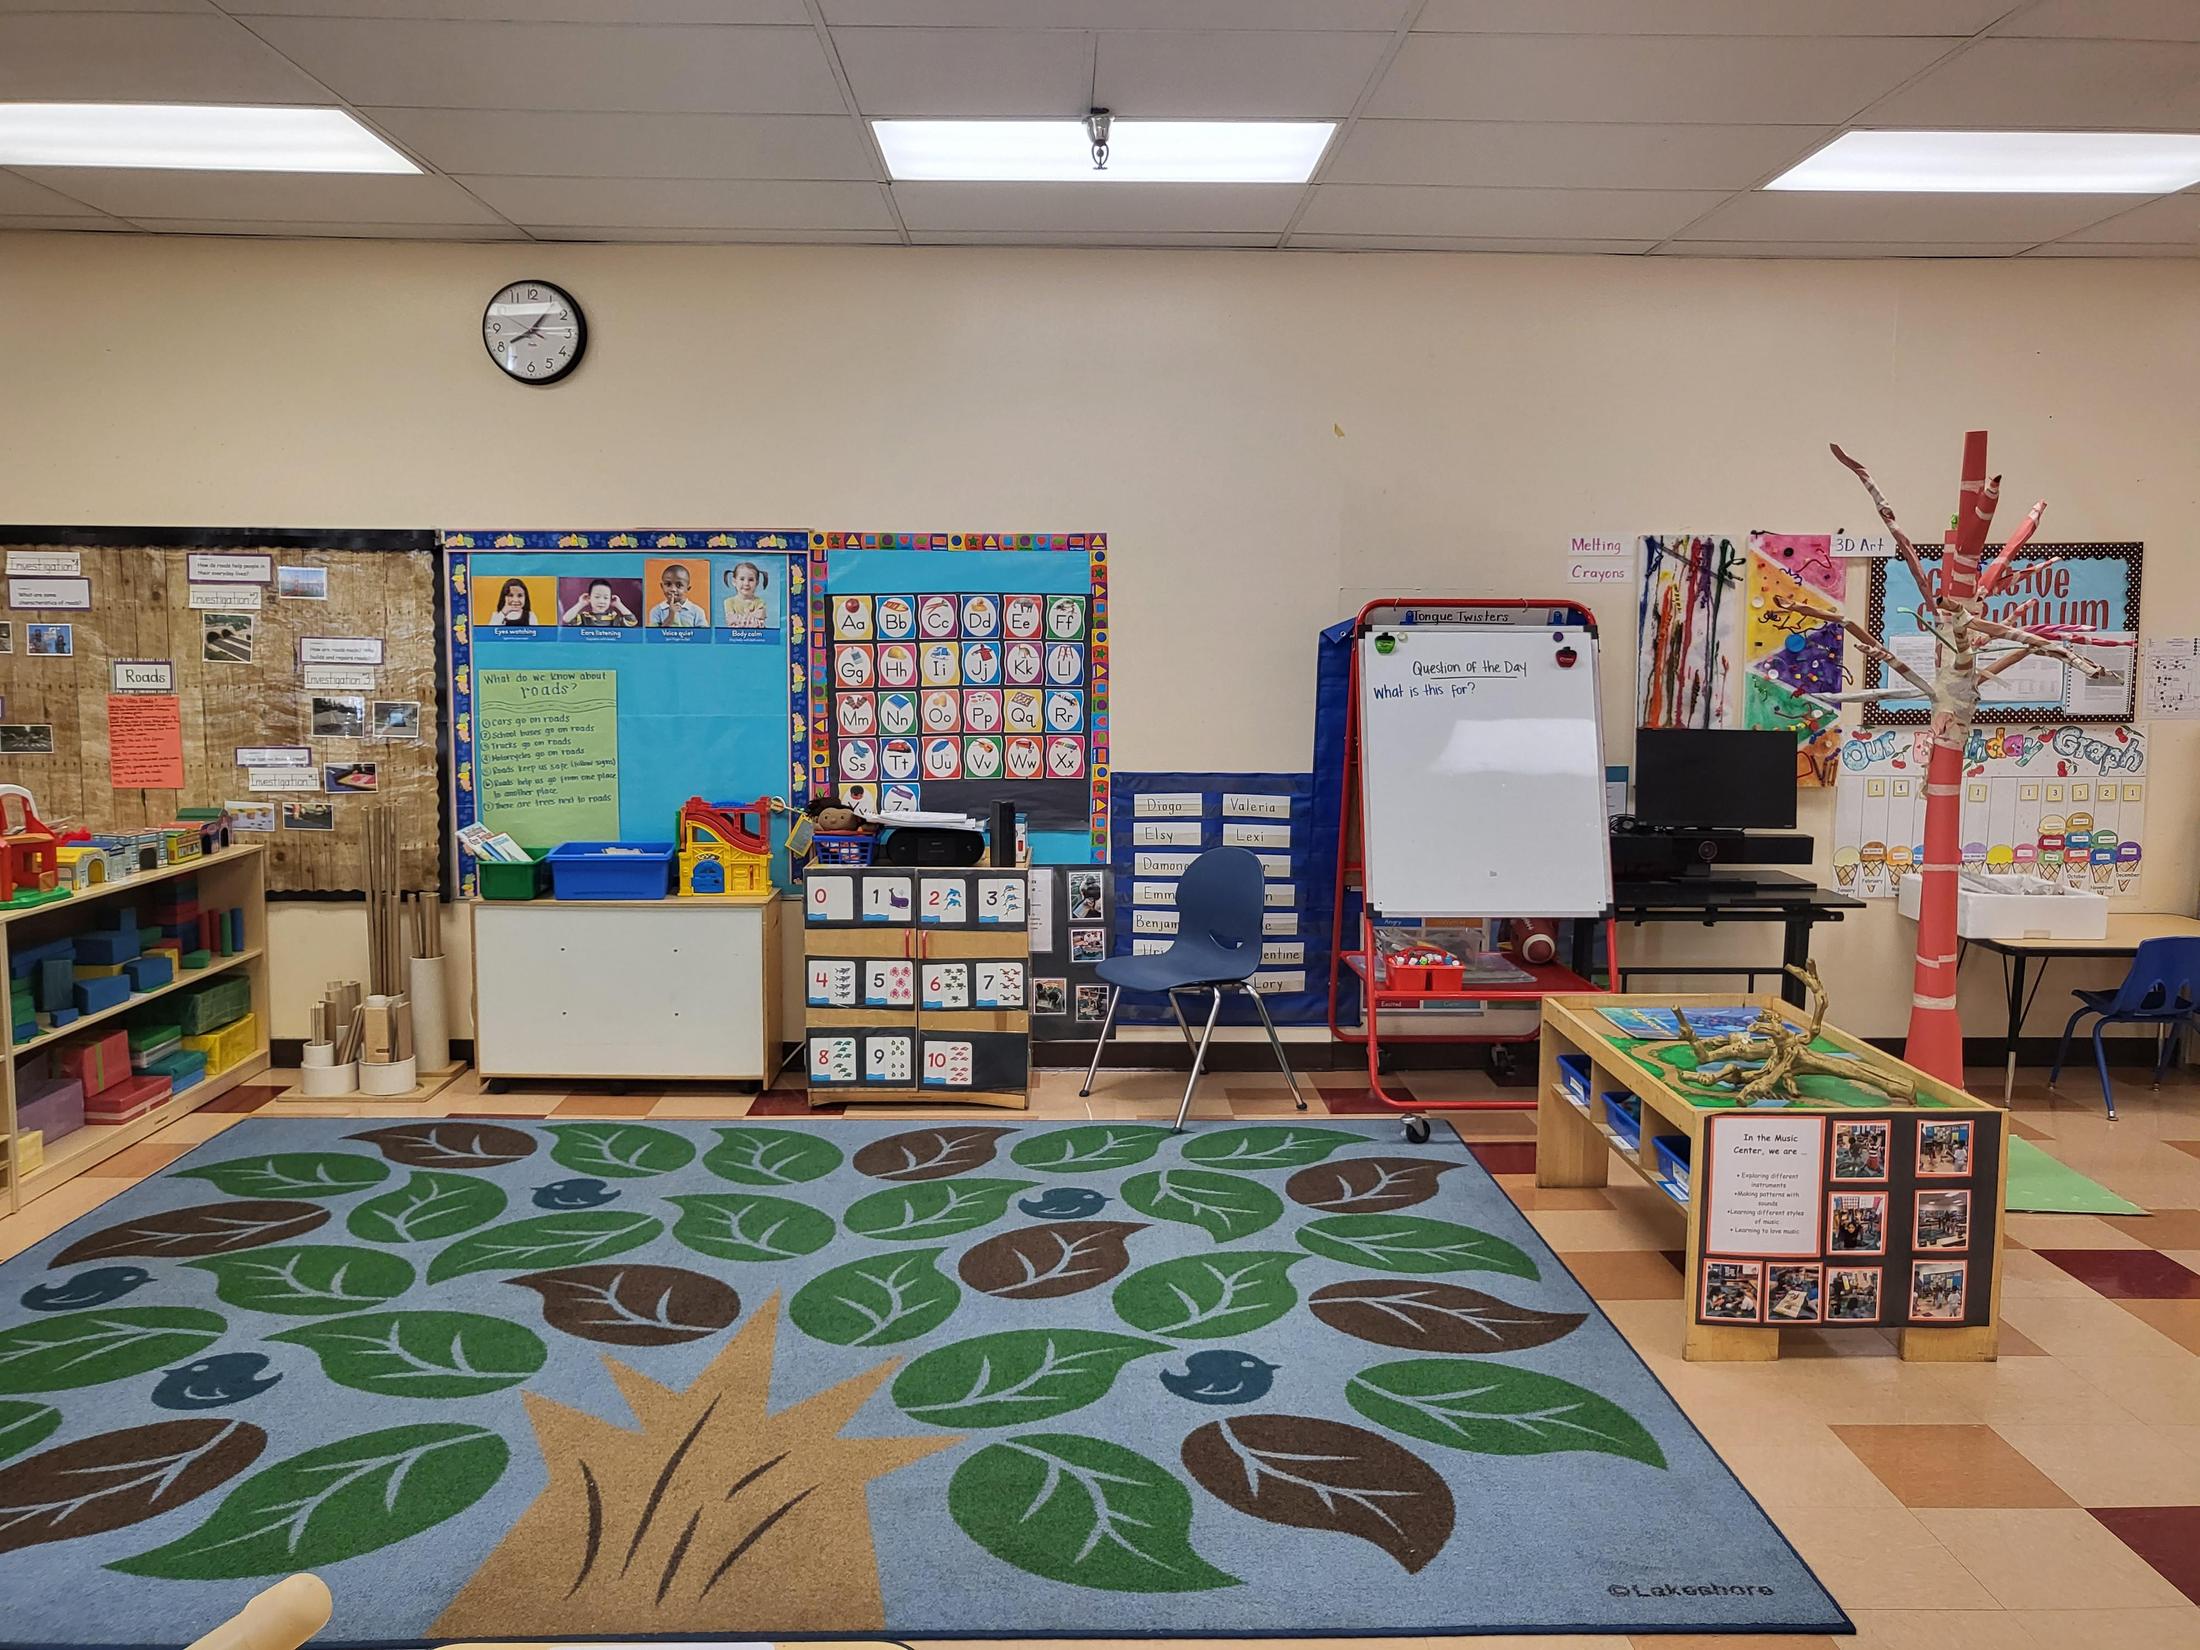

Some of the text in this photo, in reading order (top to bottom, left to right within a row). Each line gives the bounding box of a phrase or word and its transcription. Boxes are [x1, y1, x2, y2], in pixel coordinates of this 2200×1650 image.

[527, 288, 538, 300] 12
[560, 309, 568, 321] 2
[493, 323, 501, 334] 9
[564, 328, 572, 339] 3
[497, 341, 505, 352] 8
[559, 346, 566, 357] 4
[527, 361, 535, 373] 6
[545, 358, 554, 369] 5
[1571, 537, 1621, 555] Melting
[1836, 538, 1884, 551] 3D Art
[1571, 564, 1625, 583] Crayons
[192, 591, 249, 607] Investigation
[841, 615, 865, 630] Aa
[886, 614, 907, 630] Bb
[928, 613, 949, 629] Cc
[969, 613, 991, 629] Dd
[1012, 613, 1030, 629] Ee
[1056, 614, 1074, 630] Ff
[1414, 610, 1509, 625] Tongue Twisters
[494, 628, 536, 636] Eyes watching
[595, 630, 622, 638] listening
[678, 630, 694, 638] quiet
[732, 630, 747, 638] Body
[841, 662, 864, 684] Gg
[886, 662, 907, 677] Hh
[933, 660, 946, 676] Ii
[971, 660, 987, 682] Jj
[1014, 660, 1033, 675] Kk
[1412, 660, 1461, 676] Question
[1482, 660, 1501, 673] the
[1504, 660, 1527, 677] Day
[125, 668, 166, 683] Roads
[307, 671, 361, 688] Investigation
[484, 673, 511, 684] What
[516, 673, 528, 683] do
[550, 672, 575, 680] know
[580, 672, 606, 680] about
[520, 682, 578, 699] roads?
[1373, 682, 1476, 699] What is this for?
[515, 718, 526, 726] go
[543, 714, 570, 723] roads
[843, 711, 869, 726] Mm
[887, 711, 908, 726] Nn
[928, 708, 951, 723] Oo
[972, 708, 992, 729] Pp
[1011, 708, 1036, 728] Qq
[1056, 708, 1073, 723] Rr
[492, 730, 517, 739] School
[520, 729, 541, 737] buses
[545, 728, 554, 736] go
[570, 724, 595, 733] roads
[491, 741, 517, 750] Trucks
[547, 737, 571, 745] roads
[1842, 730, 1897, 772] Our
[2053, 725, 2144, 777] Graph
[535, 751, 545, 759] go
[561, 747, 585, 755] roads
[518, 764, 536, 773] keep
[550, 762, 568, 772] safe
[849, 756, 866, 772] Ss
[889, 755, 908, 771] Tt
[931, 755, 951, 770] Uu
[972, 754, 991, 769] Vv
[1011, 753, 1037, 769] Ww
[1055, 753, 1074, 769] Xx
[251, 774, 308, 789] Investigation
[547, 777, 557, 785] go
[537, 787, 557, 796] place
[588, 794, 612, 803] roads
[1147, 798, 1182, 815] Diogo
[1230, 798, 1275, 813] Valeria
[1144, 827, 1174, 842] Elsy
[1236, 828, 1264, 842] Lexi
[814, 888, 827, 904] 0
[873, 889, 879, 904] 1
[929, 891, 940, 906] 2
[986, 891, 998, 906] 3
[1144, 886, 1175, 900] Emm
[1385, 919, 1402, 927] Angry
[815, 972, 828, 987] 4
[873, 973, 885, 988] 5
[930, 976, 941, 991] 6
[983, 975, 994, 990] 7
[818, 1049, 829, 1065] 8
[874, 1049, 885, 1064] 9
[928, 1052, 946, 1067] 10
[1733, 1146, 1765, 1156] Center,
[1741, 1172, 1769, 1180] Exploring
